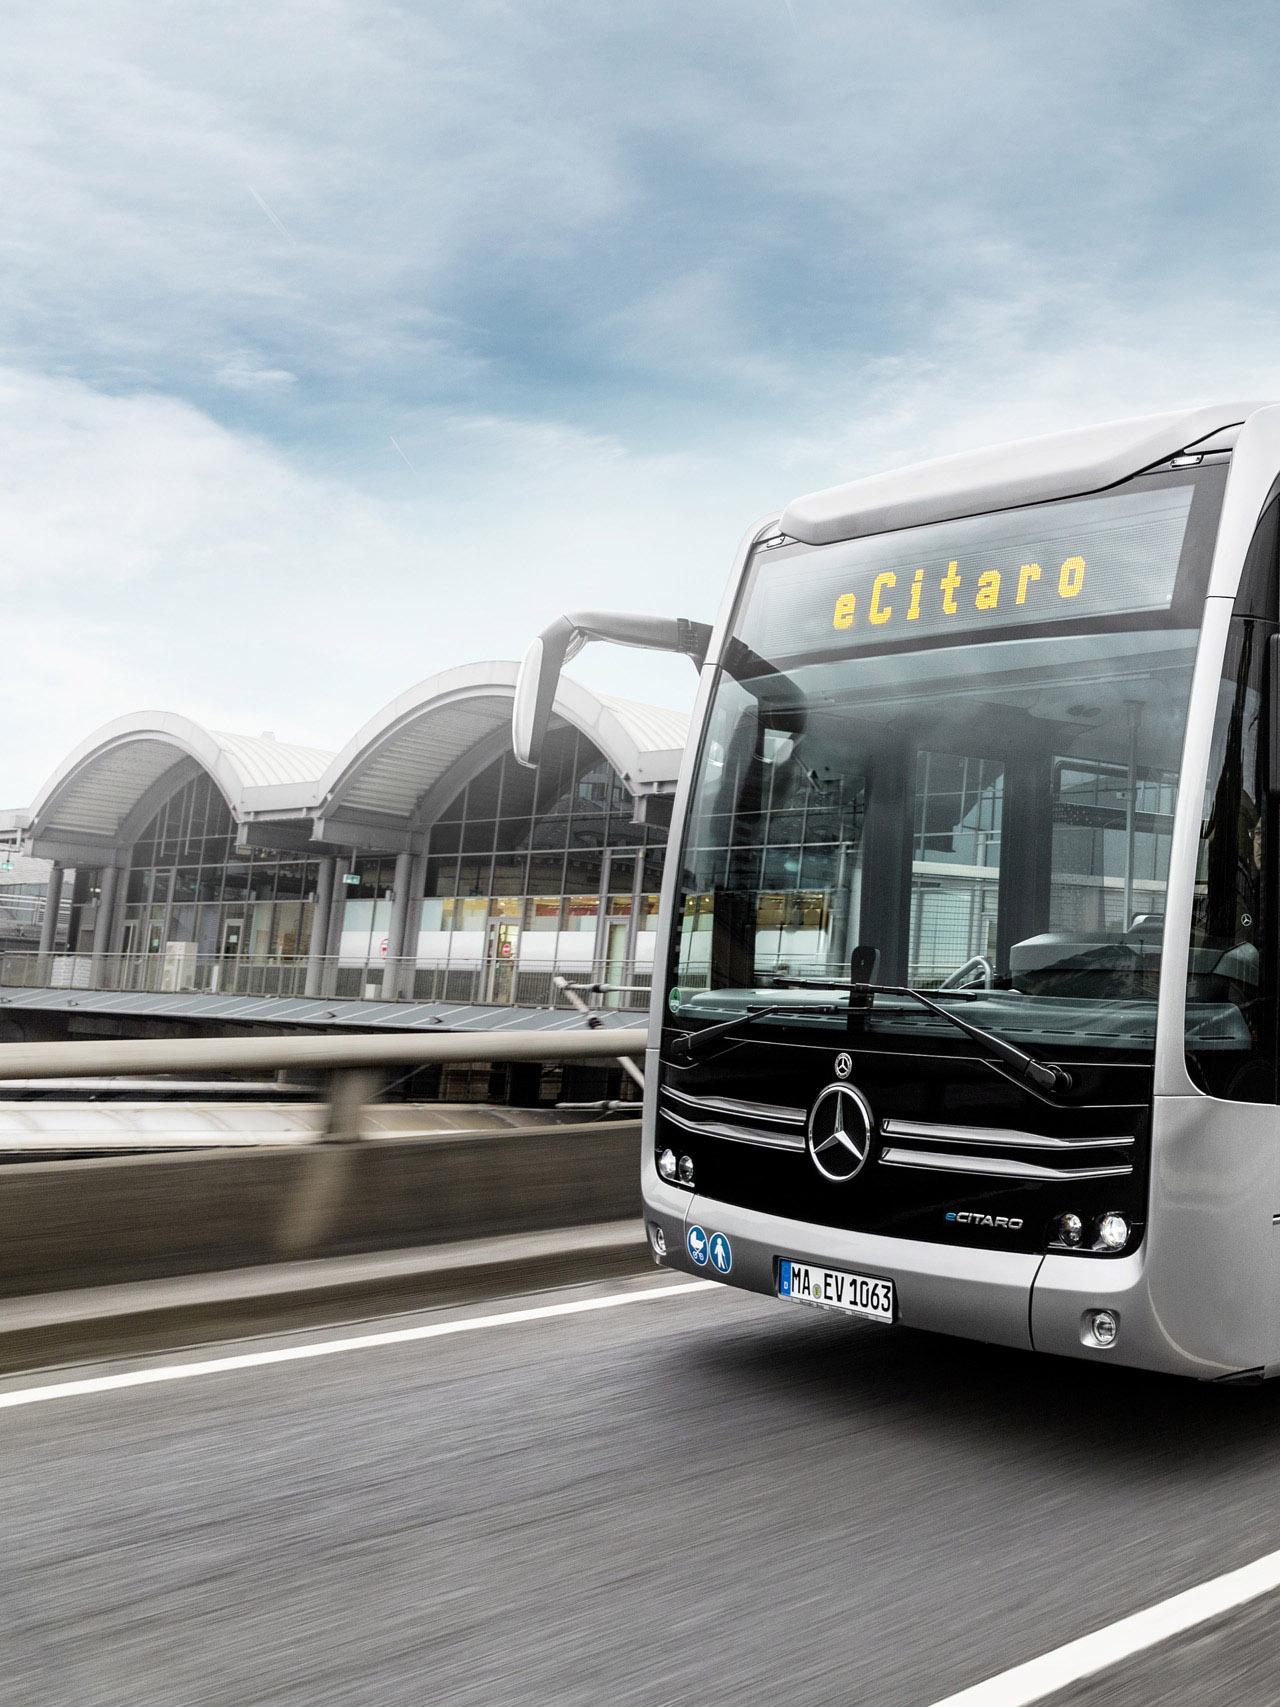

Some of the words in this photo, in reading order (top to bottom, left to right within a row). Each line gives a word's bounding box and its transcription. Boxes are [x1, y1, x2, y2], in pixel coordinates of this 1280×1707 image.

[833, 556, 1086, 629] eCitaro
[945, 1212, 1024, 1229] eCITARO
[792, 1266, 811, 1296] MA
[824, 1273, 845, 1302] EV
[850, 1279, 892, 1312] 1063
